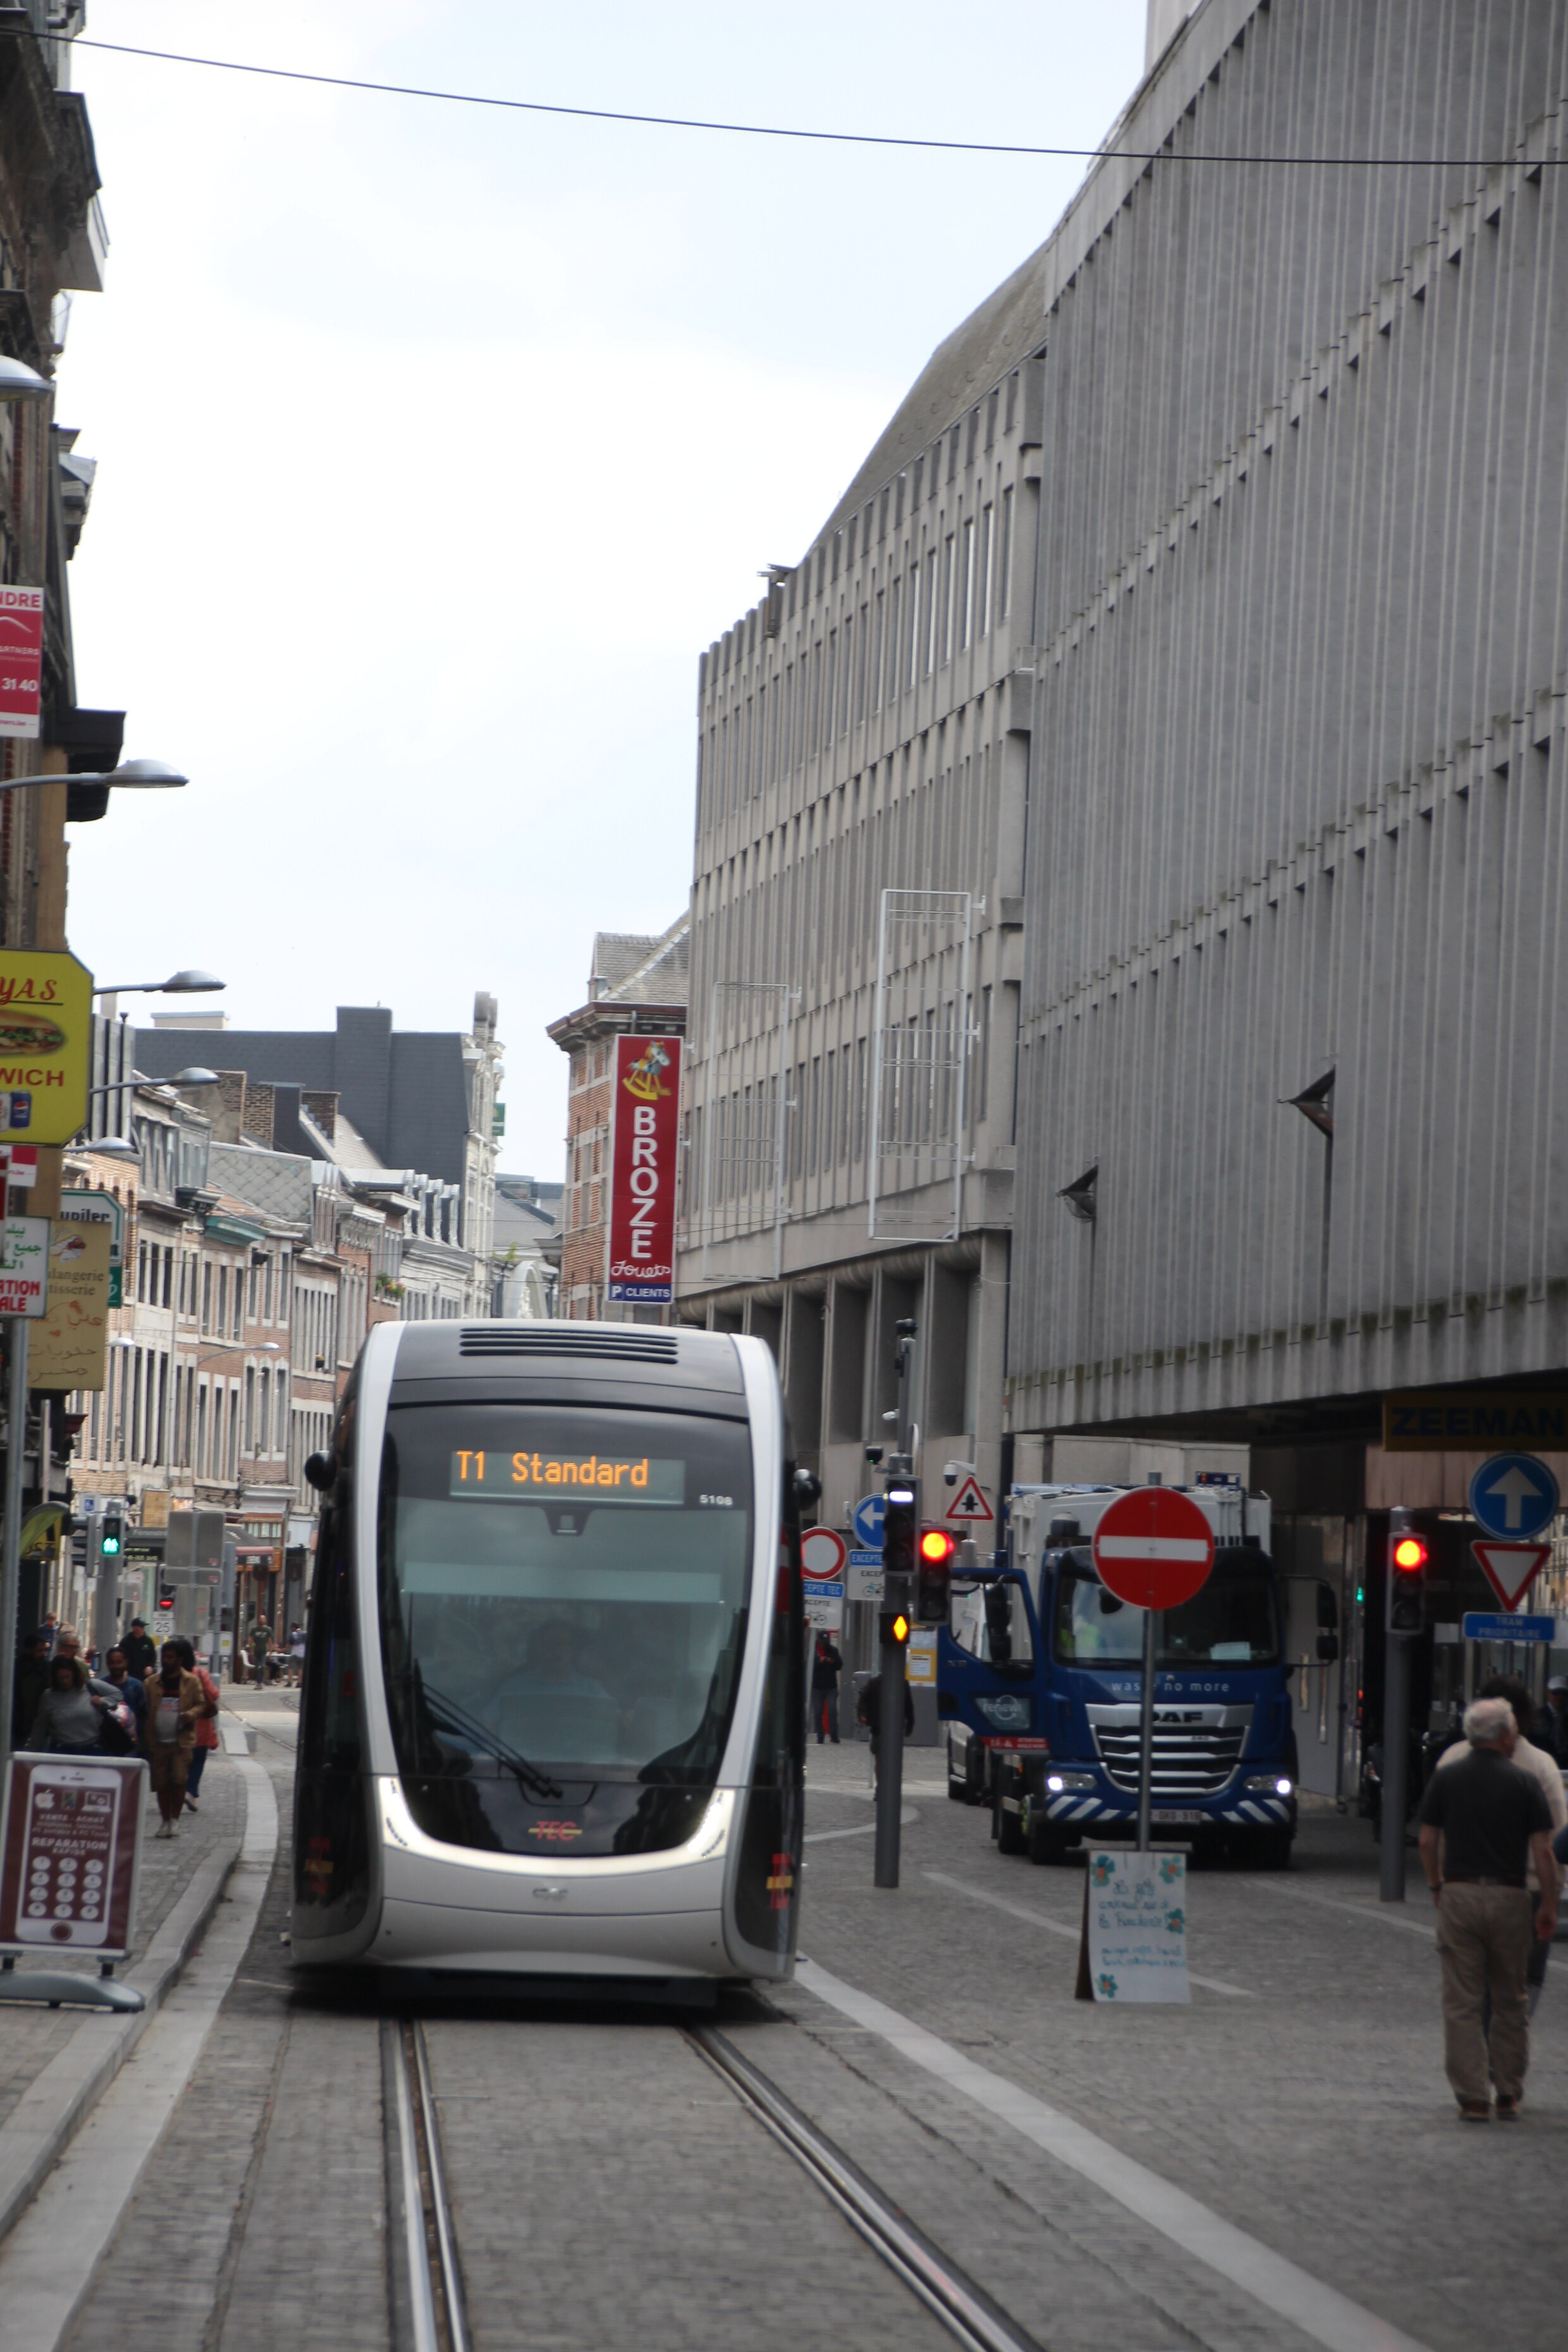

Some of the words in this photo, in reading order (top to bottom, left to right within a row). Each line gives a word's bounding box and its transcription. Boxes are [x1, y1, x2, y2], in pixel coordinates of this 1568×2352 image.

[2, 678, 17, 690] 31
[19, 678, 38, 692] 40
[629, 1105, 659, 1259] BROZE
[610, 1259, 672, 1278] Jouets
[625, 1287, 671, 1298] CLIENTS
[1392, 1407, 1565, 1436] ZEEMAN
[456, 1450, 484, 1481] T1
[511, 1452, 649, 1485] Standard
[699, 1495, 733, 1505] 5108
[155, 1622, 171, 1632] 25
[1496, 1617, 1529, 1626] TRAM
[1478, 1628, 1541, 1639] PRIORITAIRE
[1164, 1682, 1183, 1691] no
[1190, 1682, 1230, 1692] more
[536, 1821, 577, 1841] TEC
[32, 1837, 108, 1851] REPARATION
